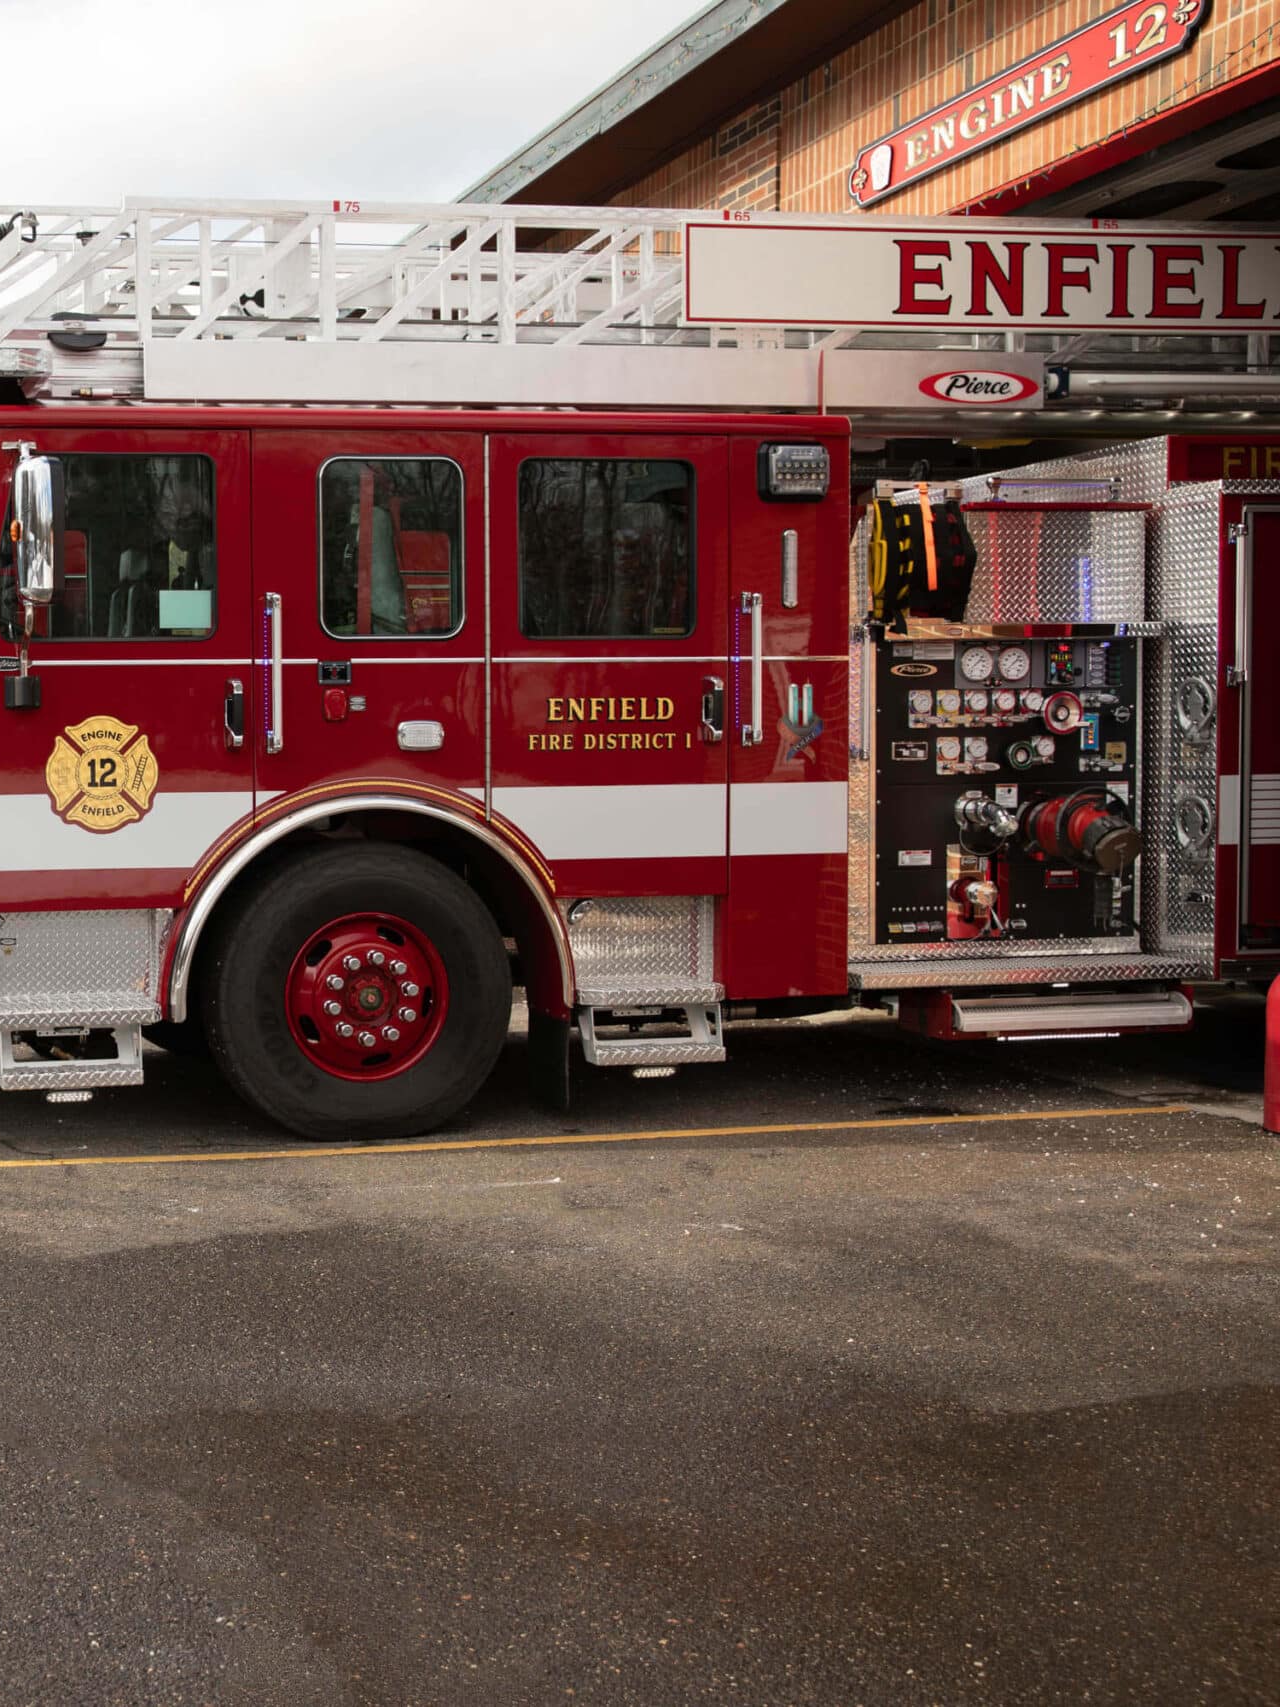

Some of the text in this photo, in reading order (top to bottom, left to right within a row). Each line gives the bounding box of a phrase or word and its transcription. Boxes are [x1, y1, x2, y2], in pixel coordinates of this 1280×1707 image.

[904, 3, 1169, 172] ENGINE 12
[344, 201, 360, 212] 75
[734, 211, 750, 221] 65
[892, 239, 1280, 319] ENFIEL
[944, 374, 1011, 397] Pierce
[546, 697, 675, 722] ENFIELD
[80, 729, 123, 743] ENGINE
[528, 734, 574, 751] FIRE
[584, 733, 676, 751] DISTRICT
[87, 757, 118, 788] 12
[80, 804, 125, 817] ENFIELD
